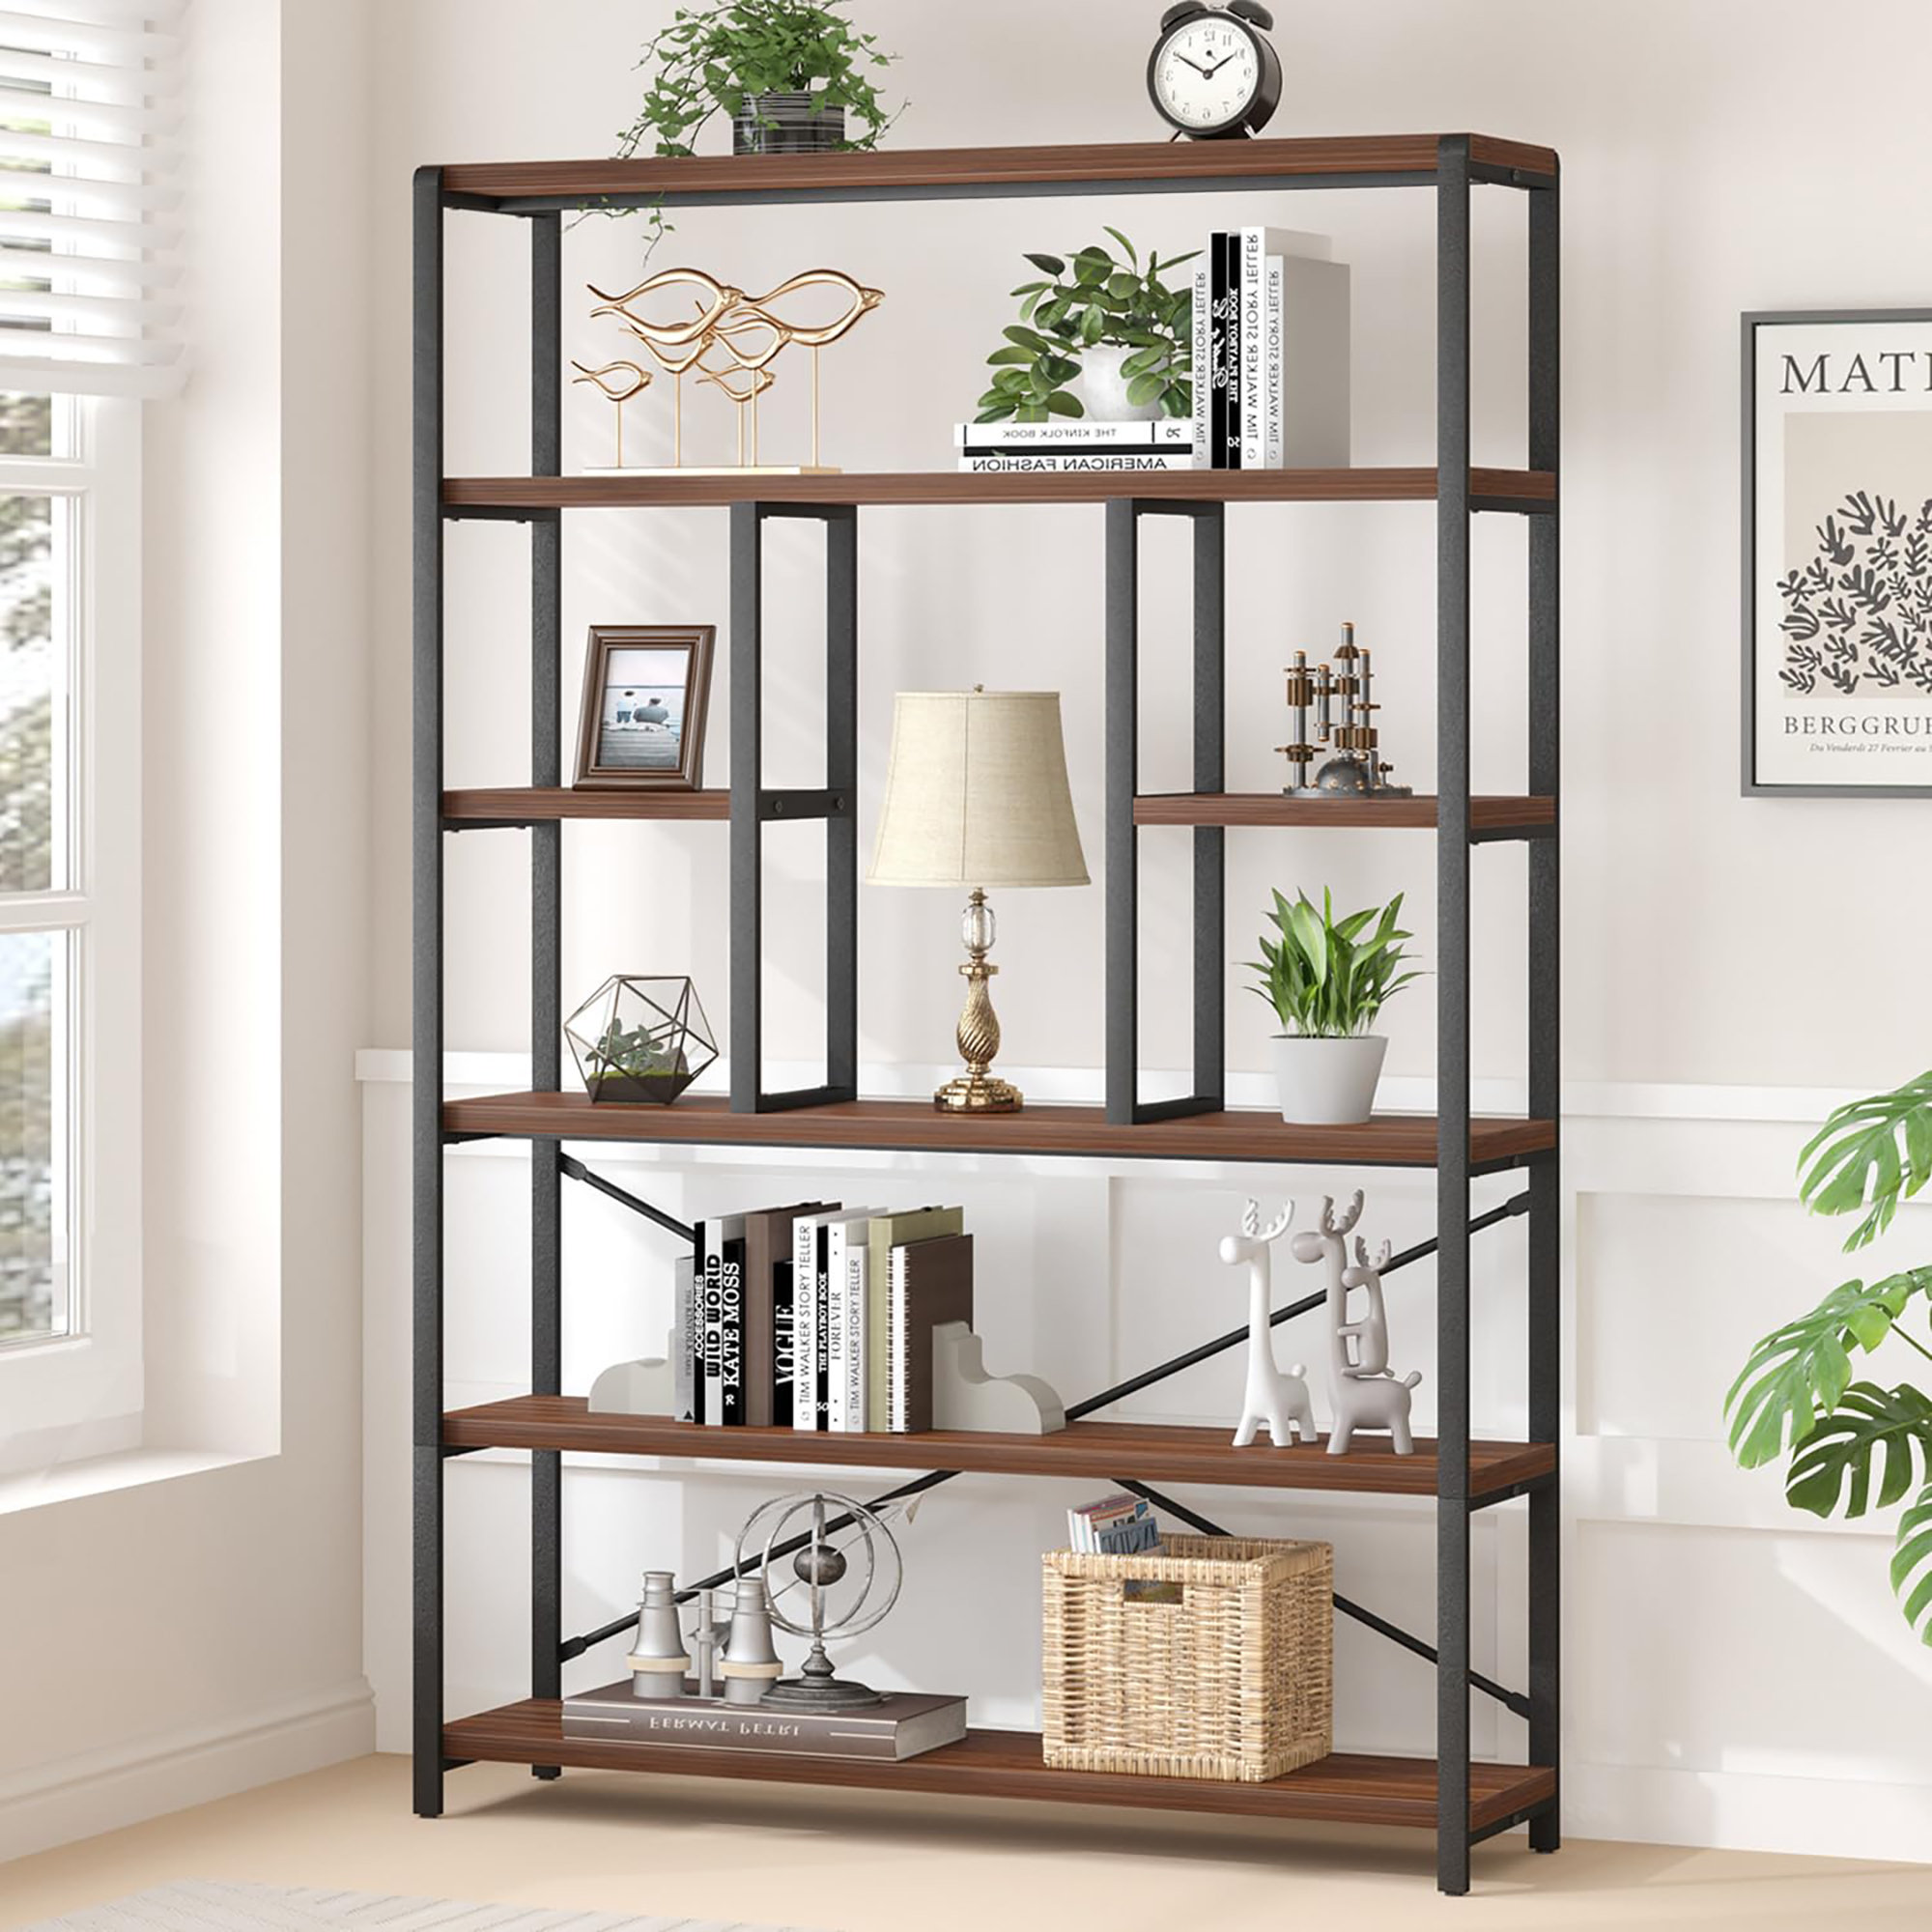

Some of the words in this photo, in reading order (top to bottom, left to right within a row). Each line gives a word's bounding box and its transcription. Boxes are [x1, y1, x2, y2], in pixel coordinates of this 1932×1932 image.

[799, 1225, 810, 1268] TELLER
[706, 1254, 721, 1324] WORLD
[724, 1263, 740, 1323] MOSS
[799, 1273, 810, 1318] STORY
[850, 1259, 860, 1295] TELLER
[695, 1274, 704, 1360] ACCESSORIES
[831, 1292, 841, 1360] FOREVER
[850, 1300, 860, 1337] STORY
[706, 1330, 721, 1378] WILD
[724, 1328, 740, 1387] KATE
[775, 1304, 794, 1386] VOGUE
[799, 1321, 810, 1378] WALKER
[850, 1340, 860, 1387] WALKER
[799, 1380, 810, 1404] TIM
[850, 1390, 860, 1409] TIM
